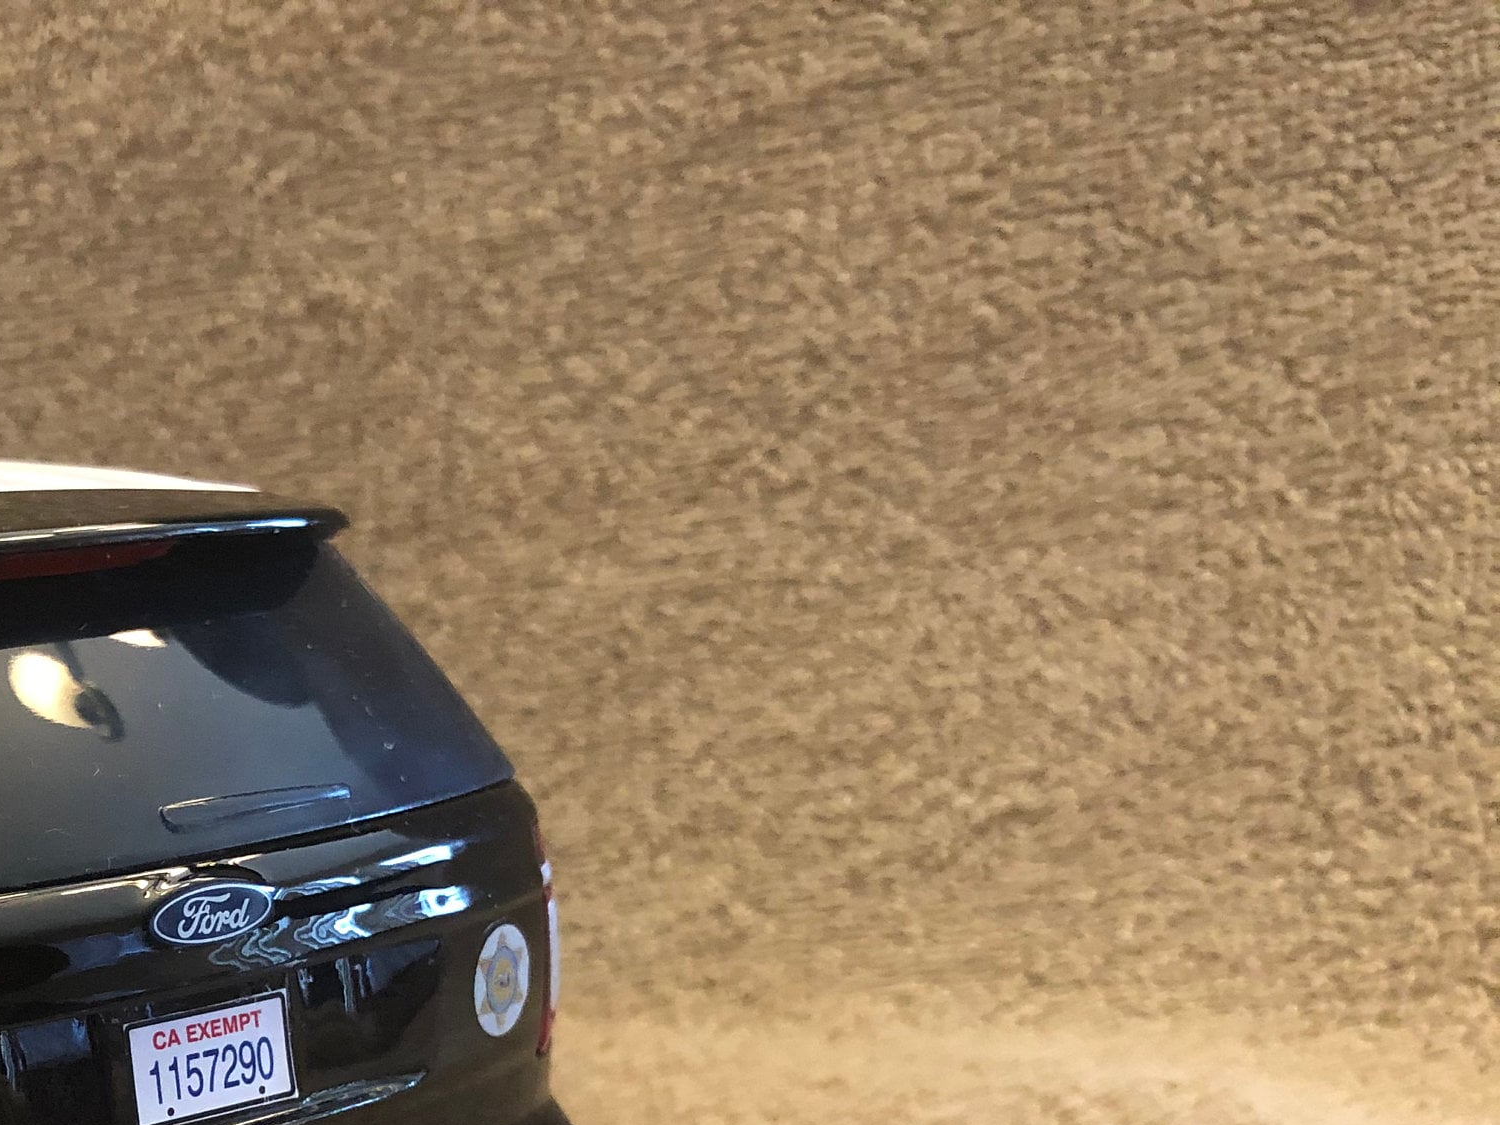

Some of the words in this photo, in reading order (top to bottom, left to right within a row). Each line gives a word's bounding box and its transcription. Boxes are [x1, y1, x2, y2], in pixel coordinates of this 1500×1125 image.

[178, 892, 250, 939] Ford
[153, 1029, 181, 1050] CA
[186, 1009, 262, 1043] EXEMPT
[149, 1036, 274, 1104] 1157290
